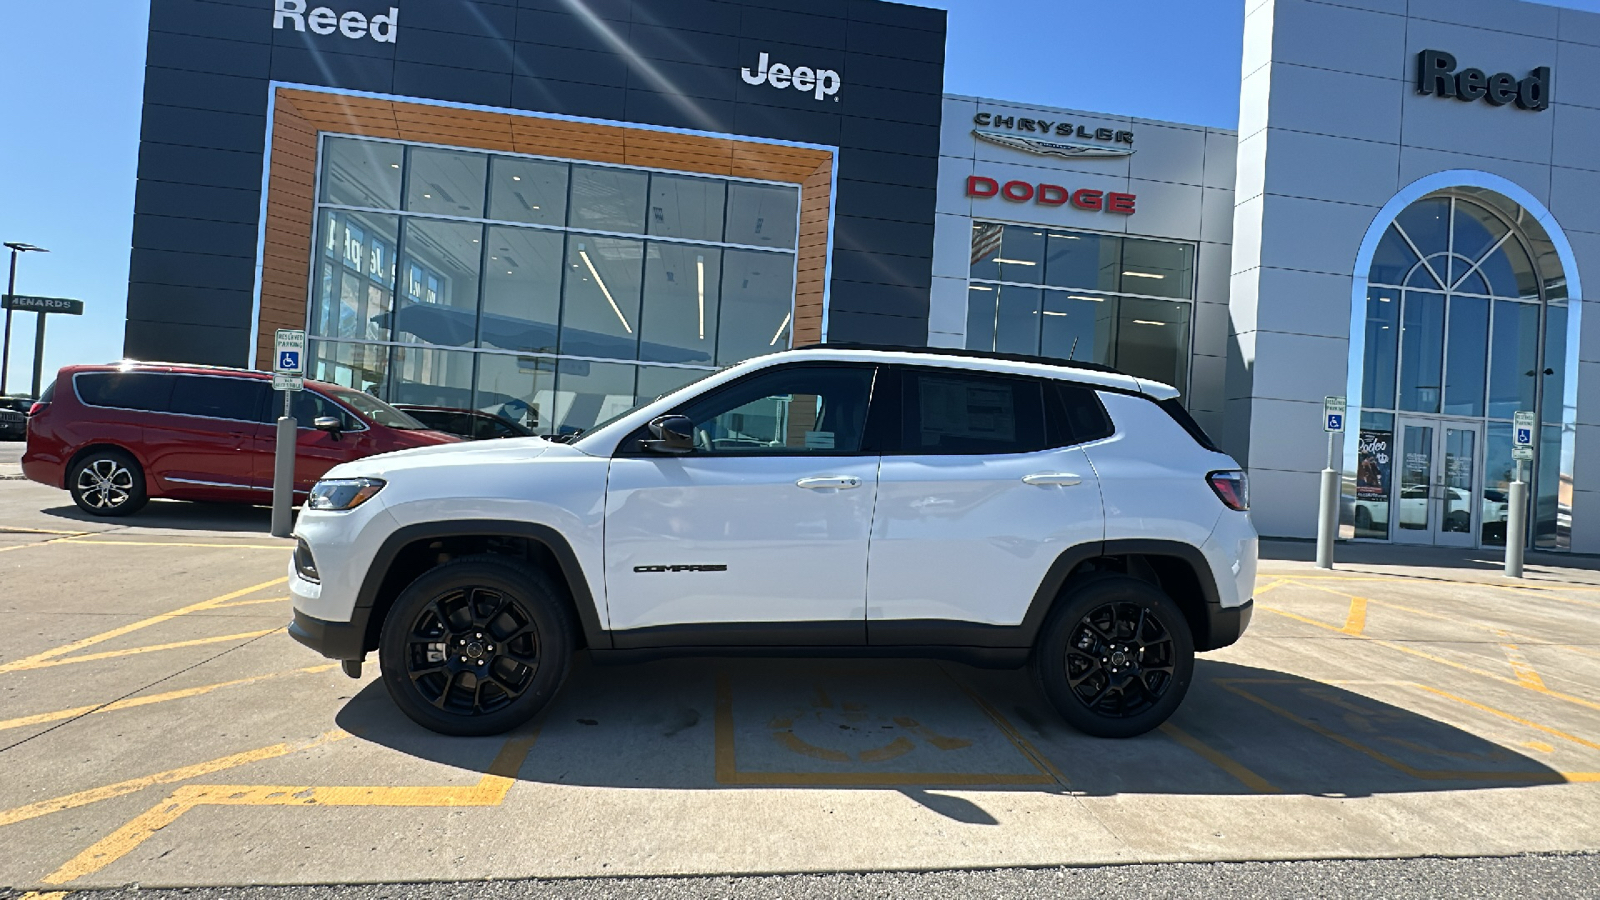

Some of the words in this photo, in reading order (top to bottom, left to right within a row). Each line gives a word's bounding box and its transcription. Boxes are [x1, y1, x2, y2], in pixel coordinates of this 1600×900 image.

[273, 0, 399, 44] Reed
[741, 52, 840, 101] Jeep
[1416, 49, 1550, 112] Reed
[973, 112, 1134, 144] CHRYSLER
[966, 175, 1136, 214] DODGE
[633, 564, 728, 573] COMPASS
